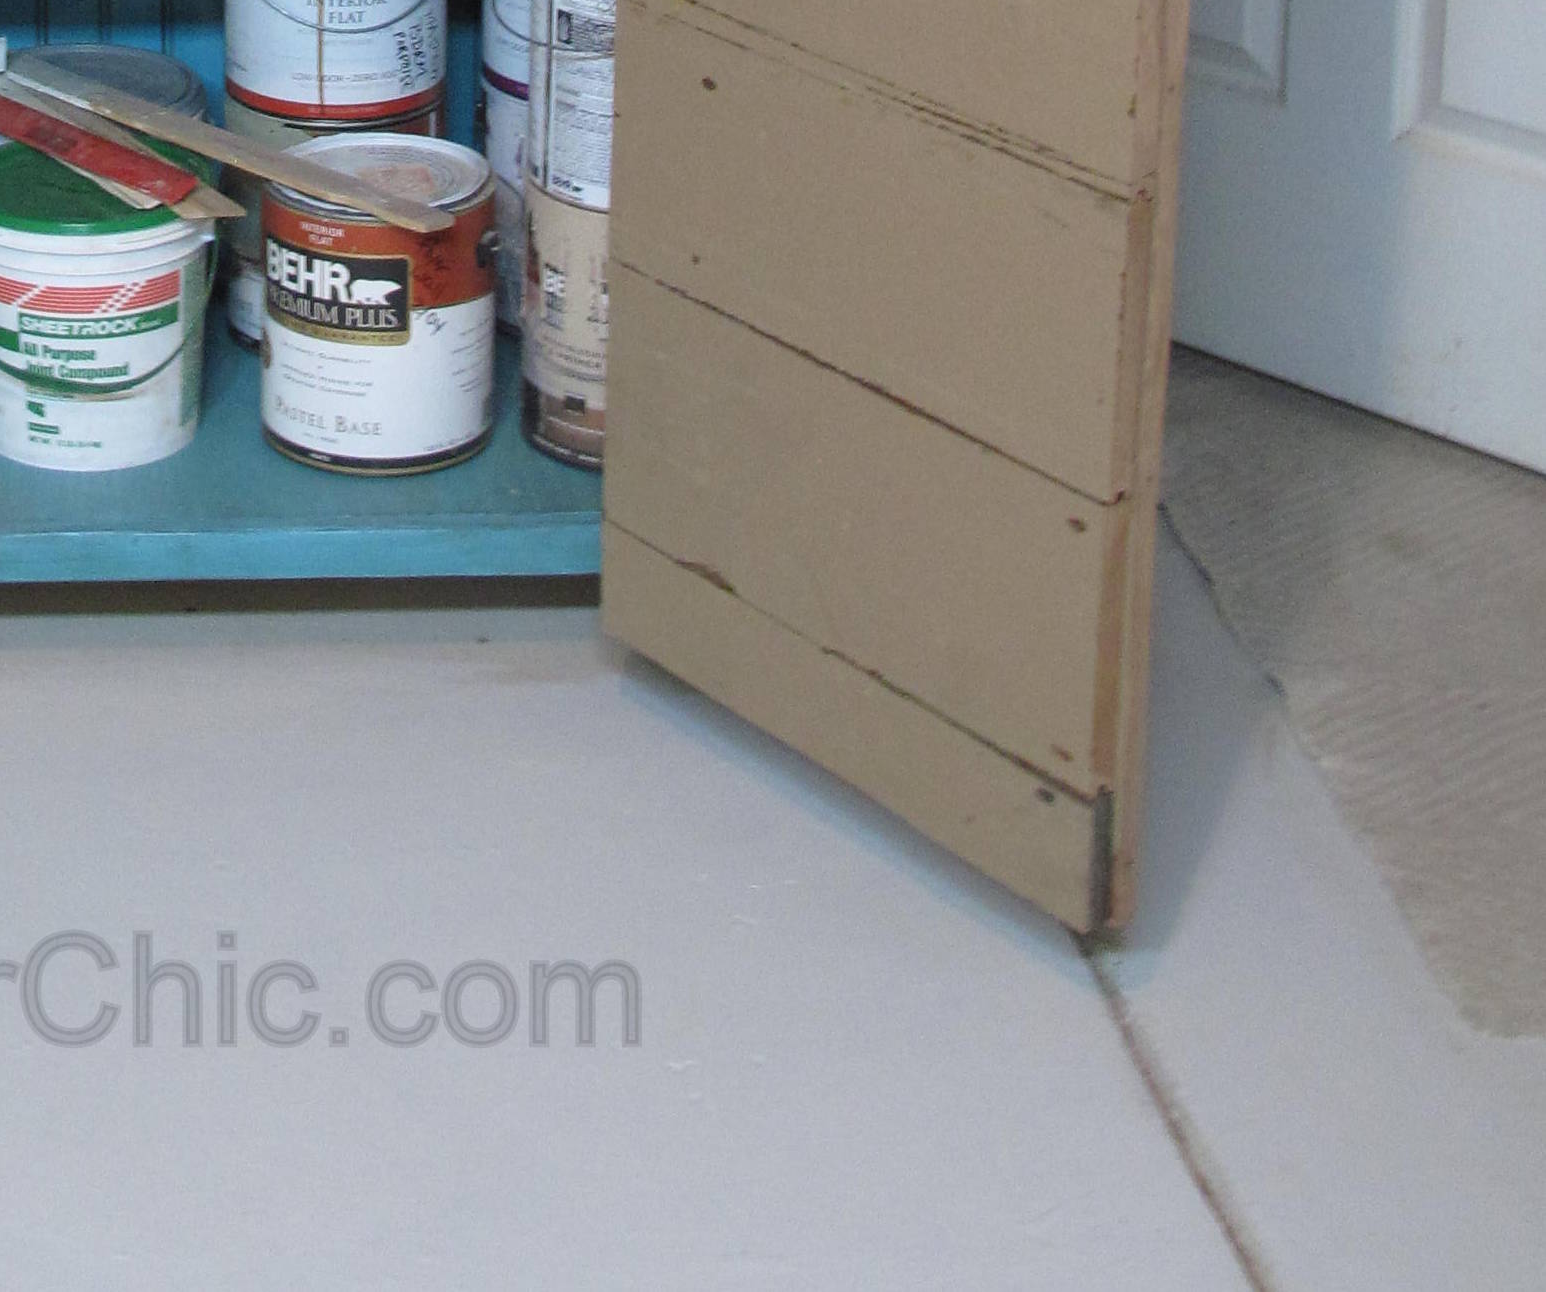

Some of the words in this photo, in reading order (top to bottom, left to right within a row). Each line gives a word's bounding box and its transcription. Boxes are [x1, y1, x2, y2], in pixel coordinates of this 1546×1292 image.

[328, 10, 367, 24] FLAT
[266, 238, 353, 303] BEHR
[345, 305, 399, 328] PLUS
[21, 317, 137, 335] SHEETROCK
[41, 345, 96, 362] Purpose
[58, 363, 129, 380] Compound
[335, 415, 383, 437] BASE
